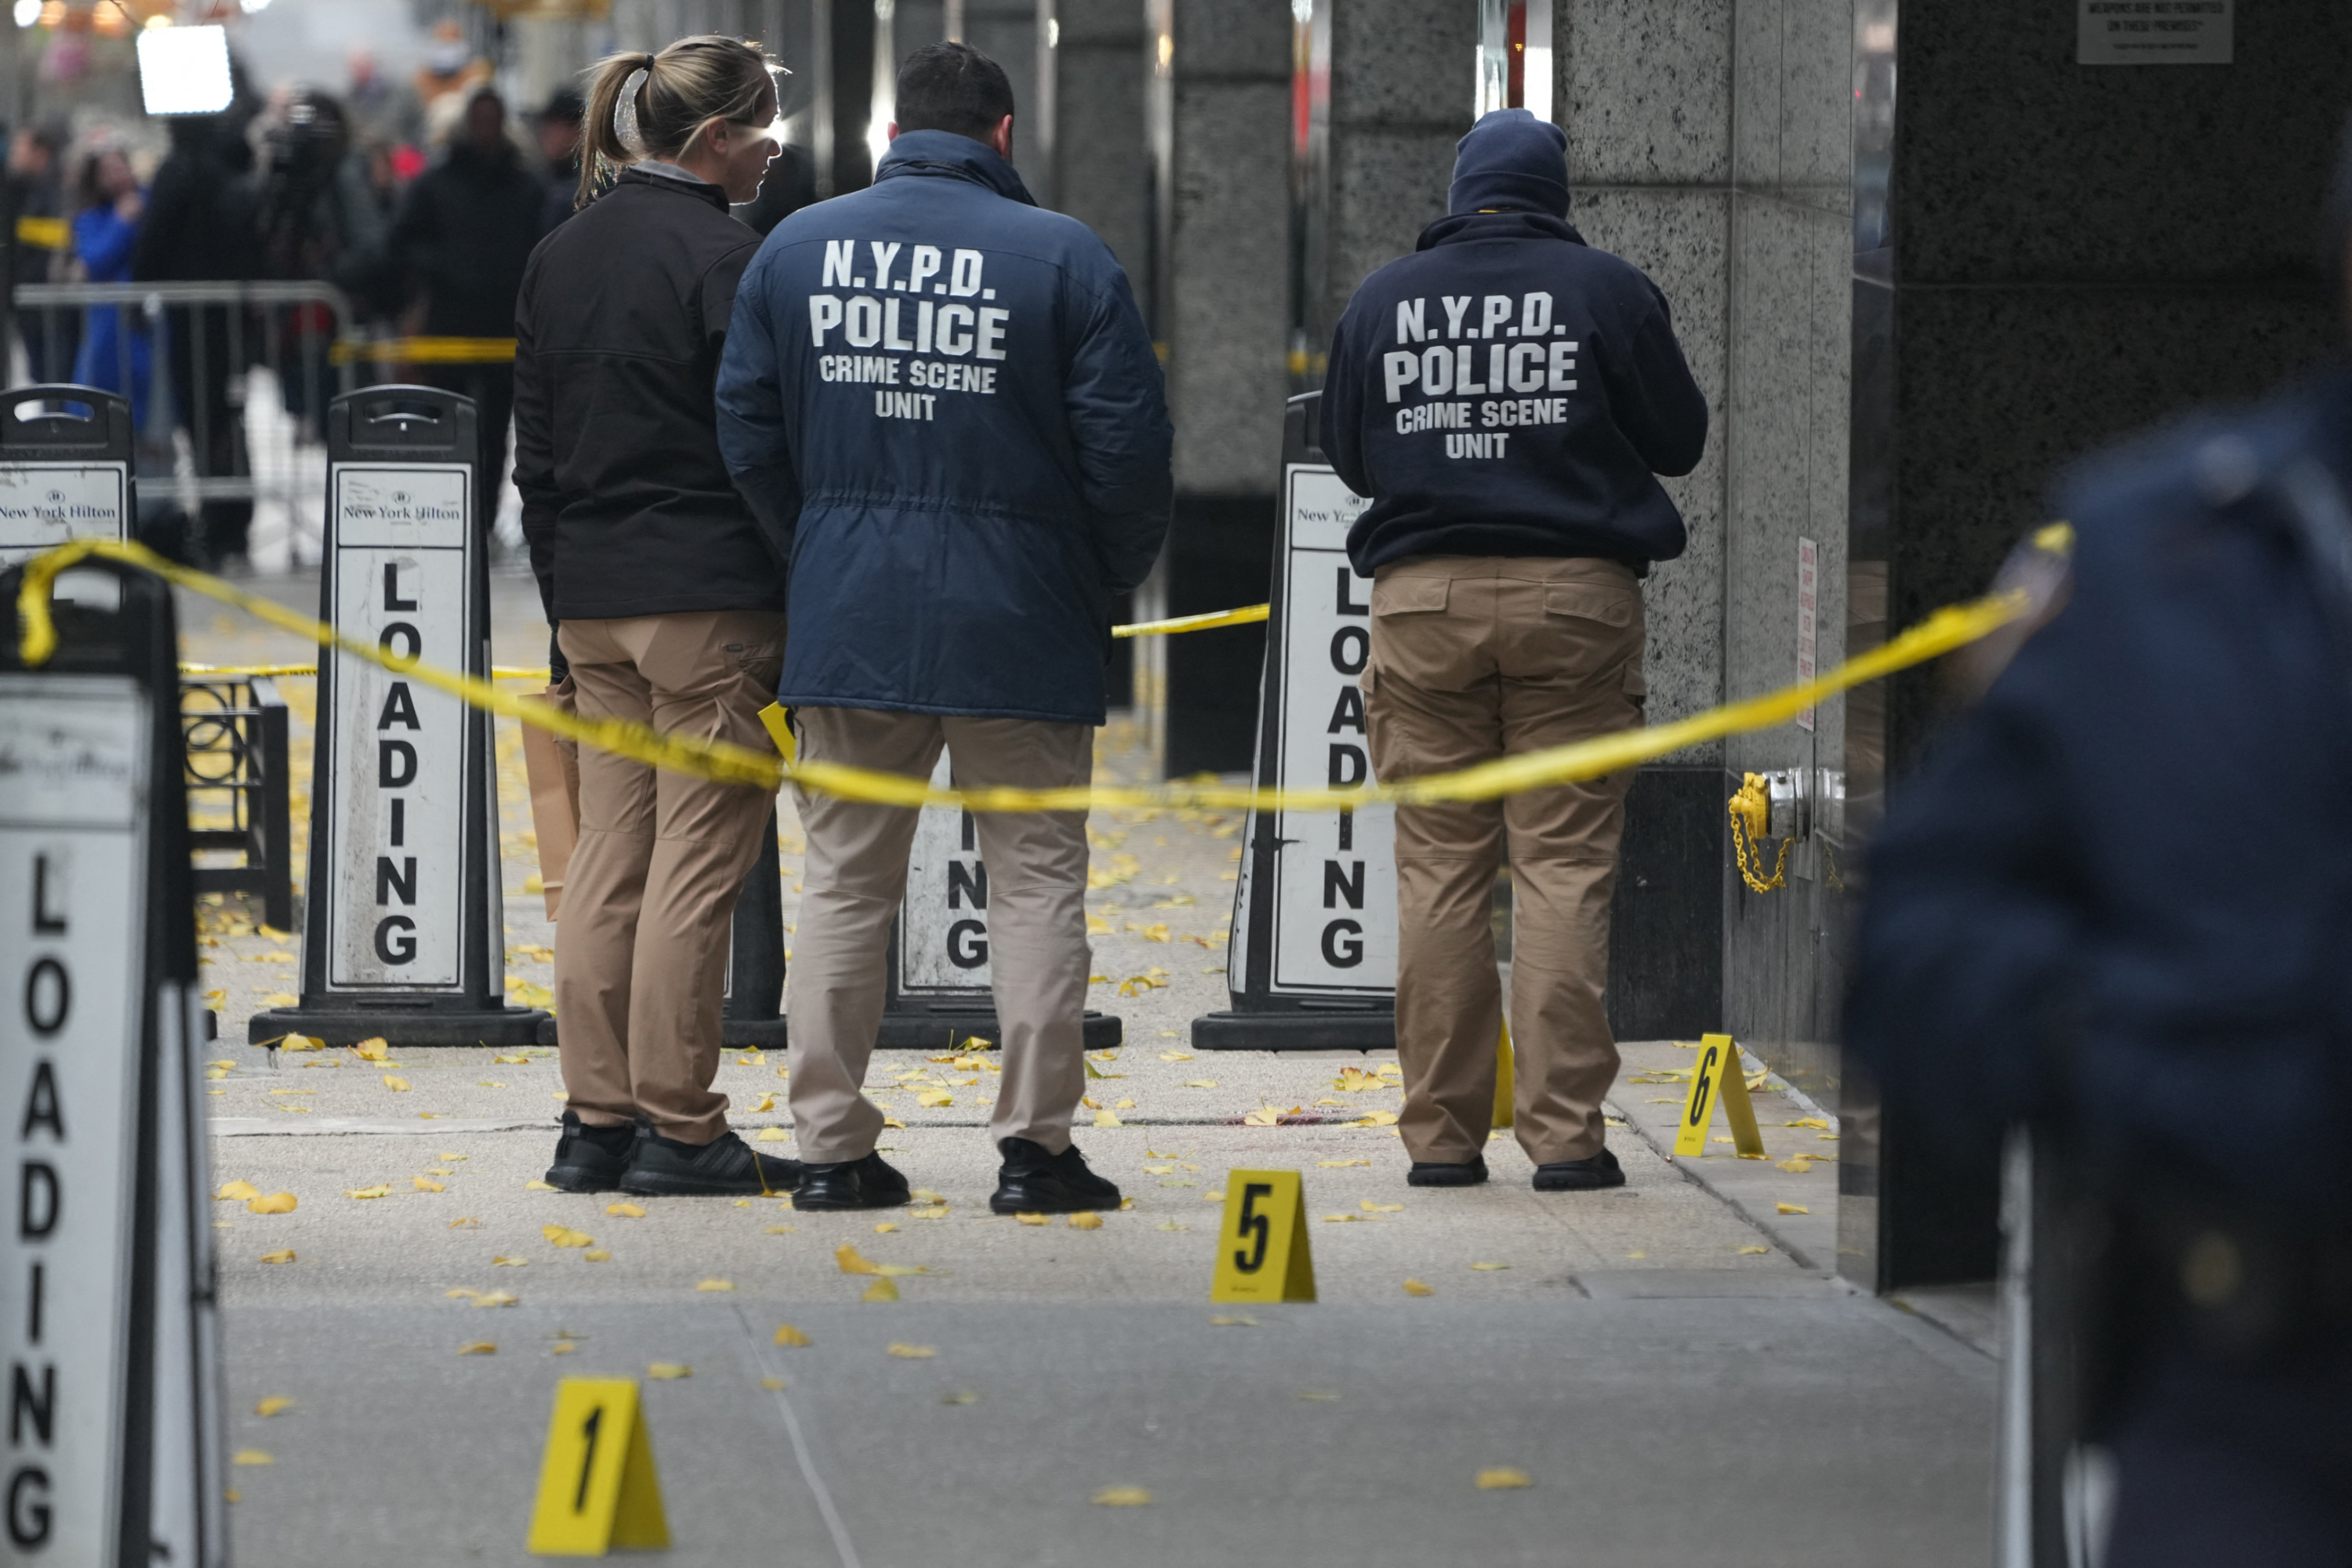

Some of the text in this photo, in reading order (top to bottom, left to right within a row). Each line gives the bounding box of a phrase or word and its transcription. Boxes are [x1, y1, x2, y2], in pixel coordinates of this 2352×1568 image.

[822, 239, 996, 300] N.Y.P.D.
[808, 294, 1010, 361] POLICE
[1396, 291, 1566, 345] N.Y.P.D.
[818, 354, 997, 394] CRIME SCENE
[1383, 341, 1579, 403] POLICE
[875, 390, 937, 421] UNIT
[1396, 397, 1569, 435] CRIME SCENE
[1445, 432, 1510, 459] UNIT
[0, 505, 117, 519] New York Hilton
[343, 506, 460, 521] New York Hilton
[1297, 507, 1329, 522] New
[373, 562, 423, 966] LOADING
[1319, 566, 1370, 969] LOADING
[1690, 1045, 1718, 1127] 6
[6, 851, 73, 1554] LOADING
[1233, 1182, 1273, 1276] 5
[573, 1405, 604, 1516] 1
